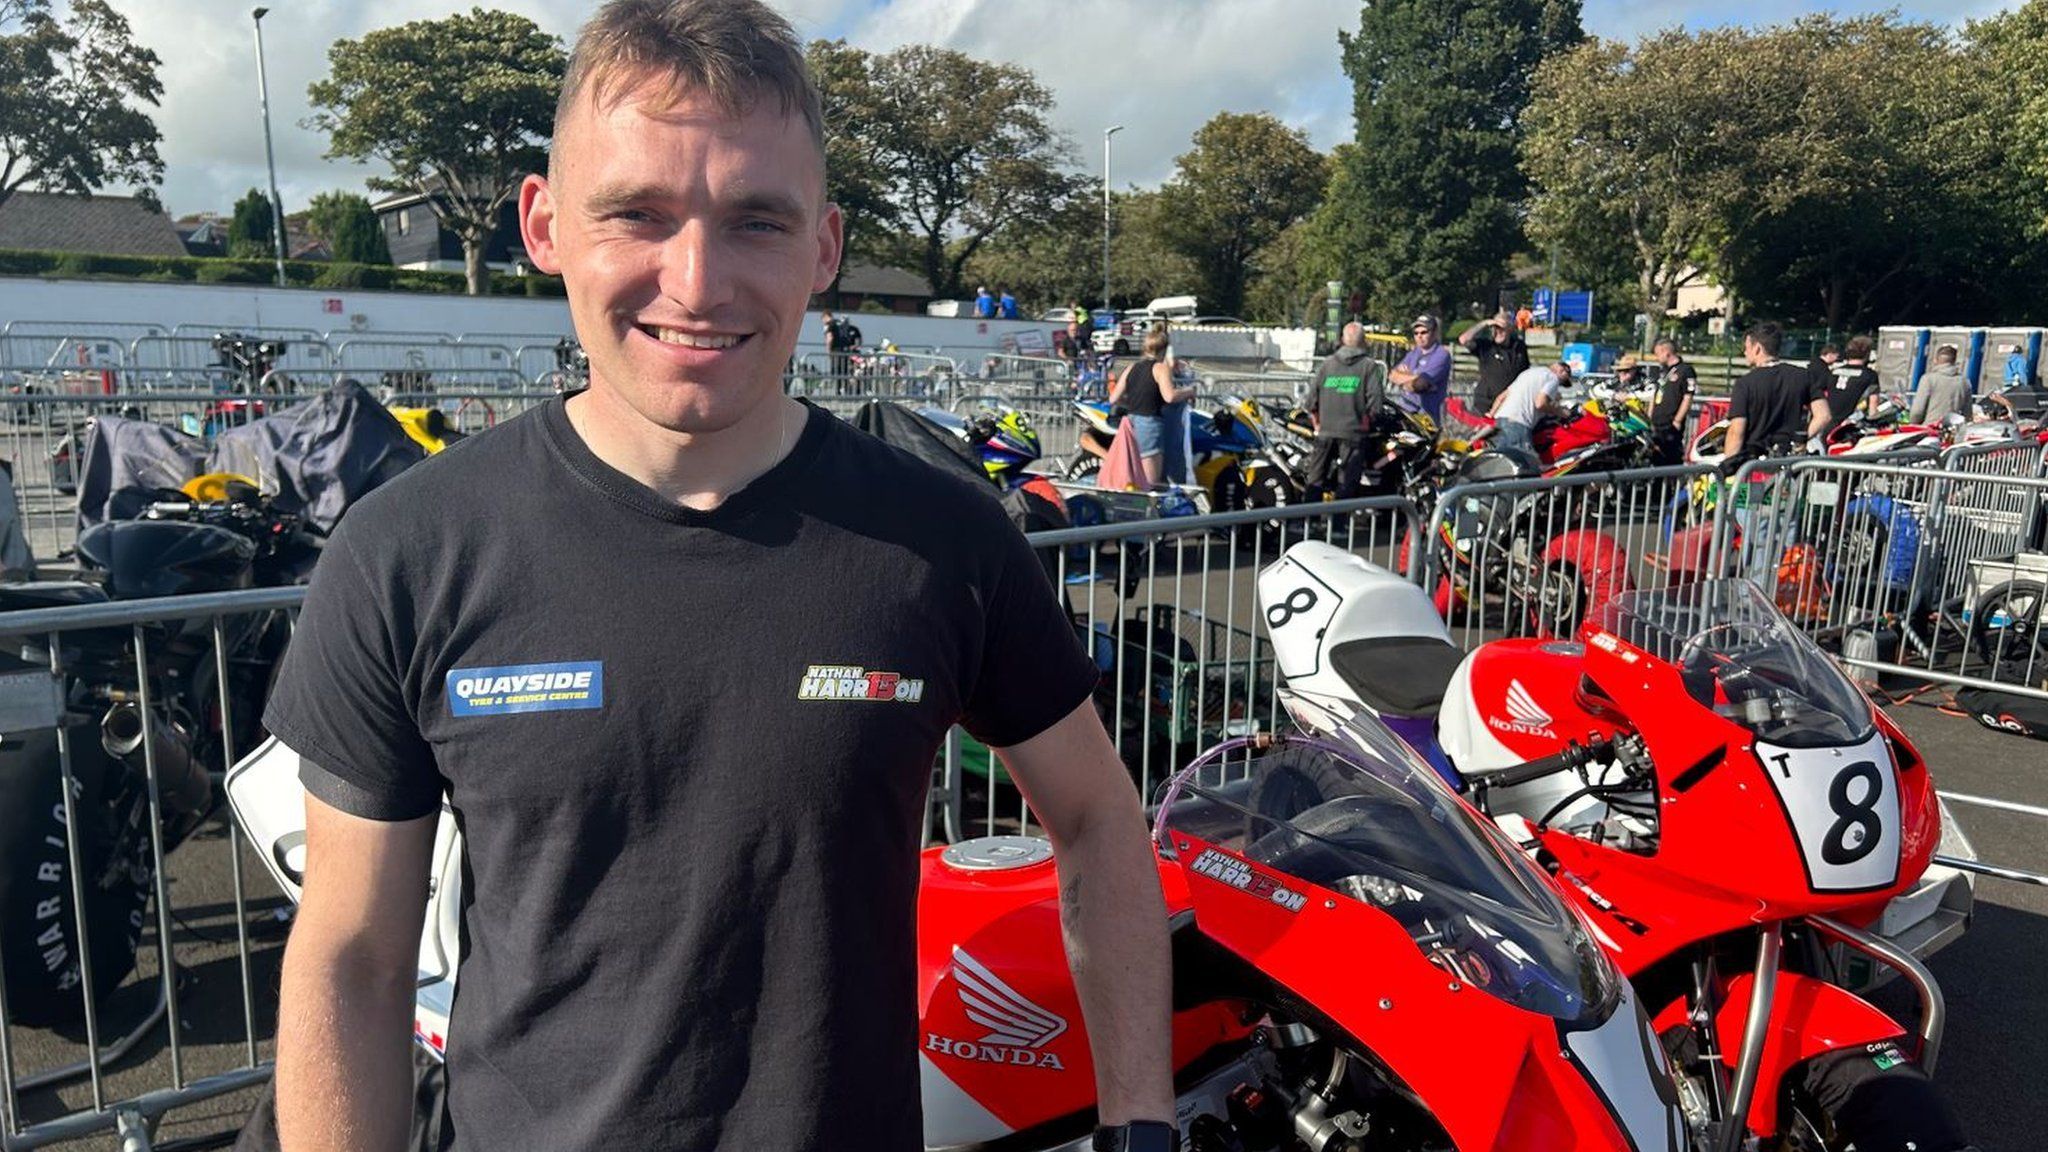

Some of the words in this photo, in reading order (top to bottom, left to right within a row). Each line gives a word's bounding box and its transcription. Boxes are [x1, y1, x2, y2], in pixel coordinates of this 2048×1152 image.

[1267, 587, 1318, 629] 8
[456, 671, 593, 698] QUAYSIDE
[808, 667, 863, 679] NATHAN
[469, 697, 493, 707] TYRE
[506, 693, 547, 704] SERVICE
[549, 691, 589, 700] CENTRE
[1489, 715, 1558, 739] HONDA
[1770, 752, 1791, 778] T
[1821, 760, 1883, 866] 8
[1203, 849, 1252, 874] NATHAN
[926, 1033, 1065, 1070] HONDA
